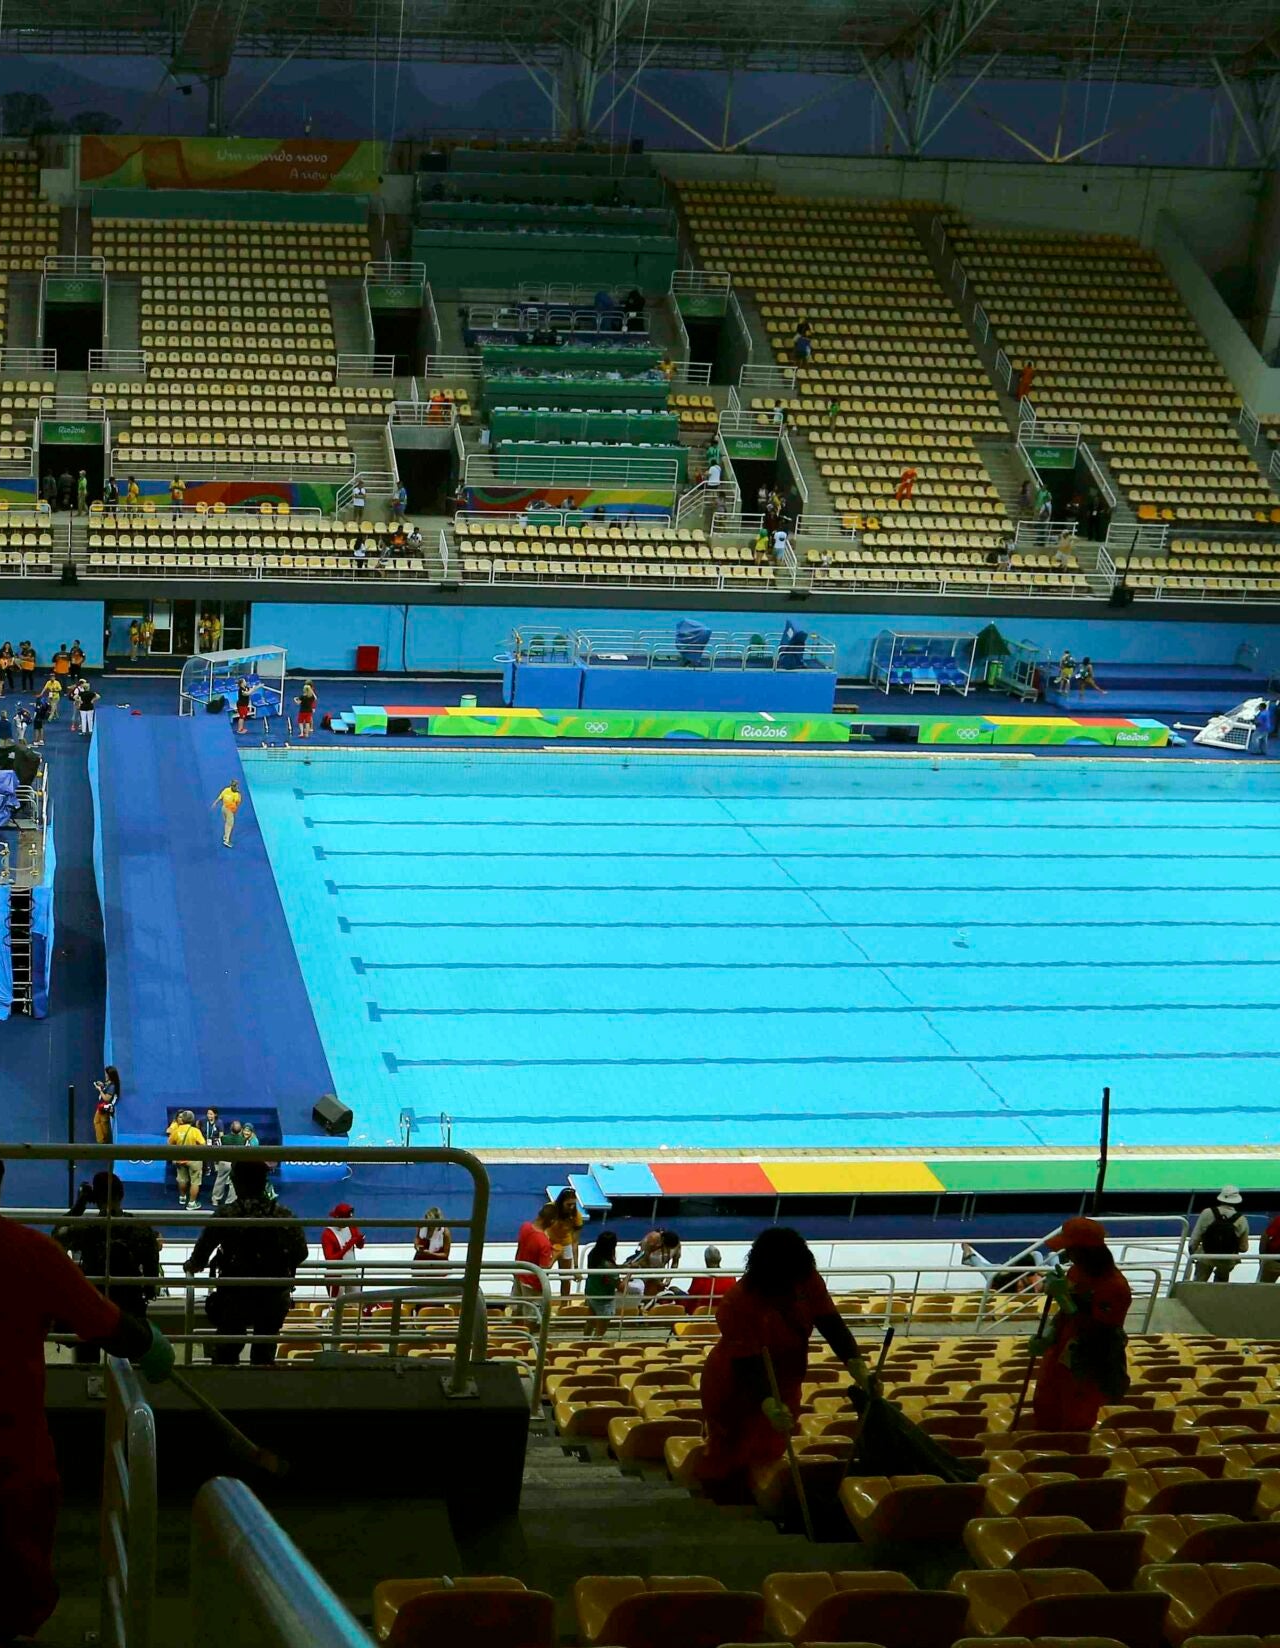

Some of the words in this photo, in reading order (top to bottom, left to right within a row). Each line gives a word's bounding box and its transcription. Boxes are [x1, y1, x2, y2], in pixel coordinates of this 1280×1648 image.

[246, 149, 294, 163] mundo
[296, 154, 329, 163] novo
[289, 168, 299, 180] A
[741, 724, 788, 738] Rio2016
[1116, 731, 1150, 742] Rio2016
